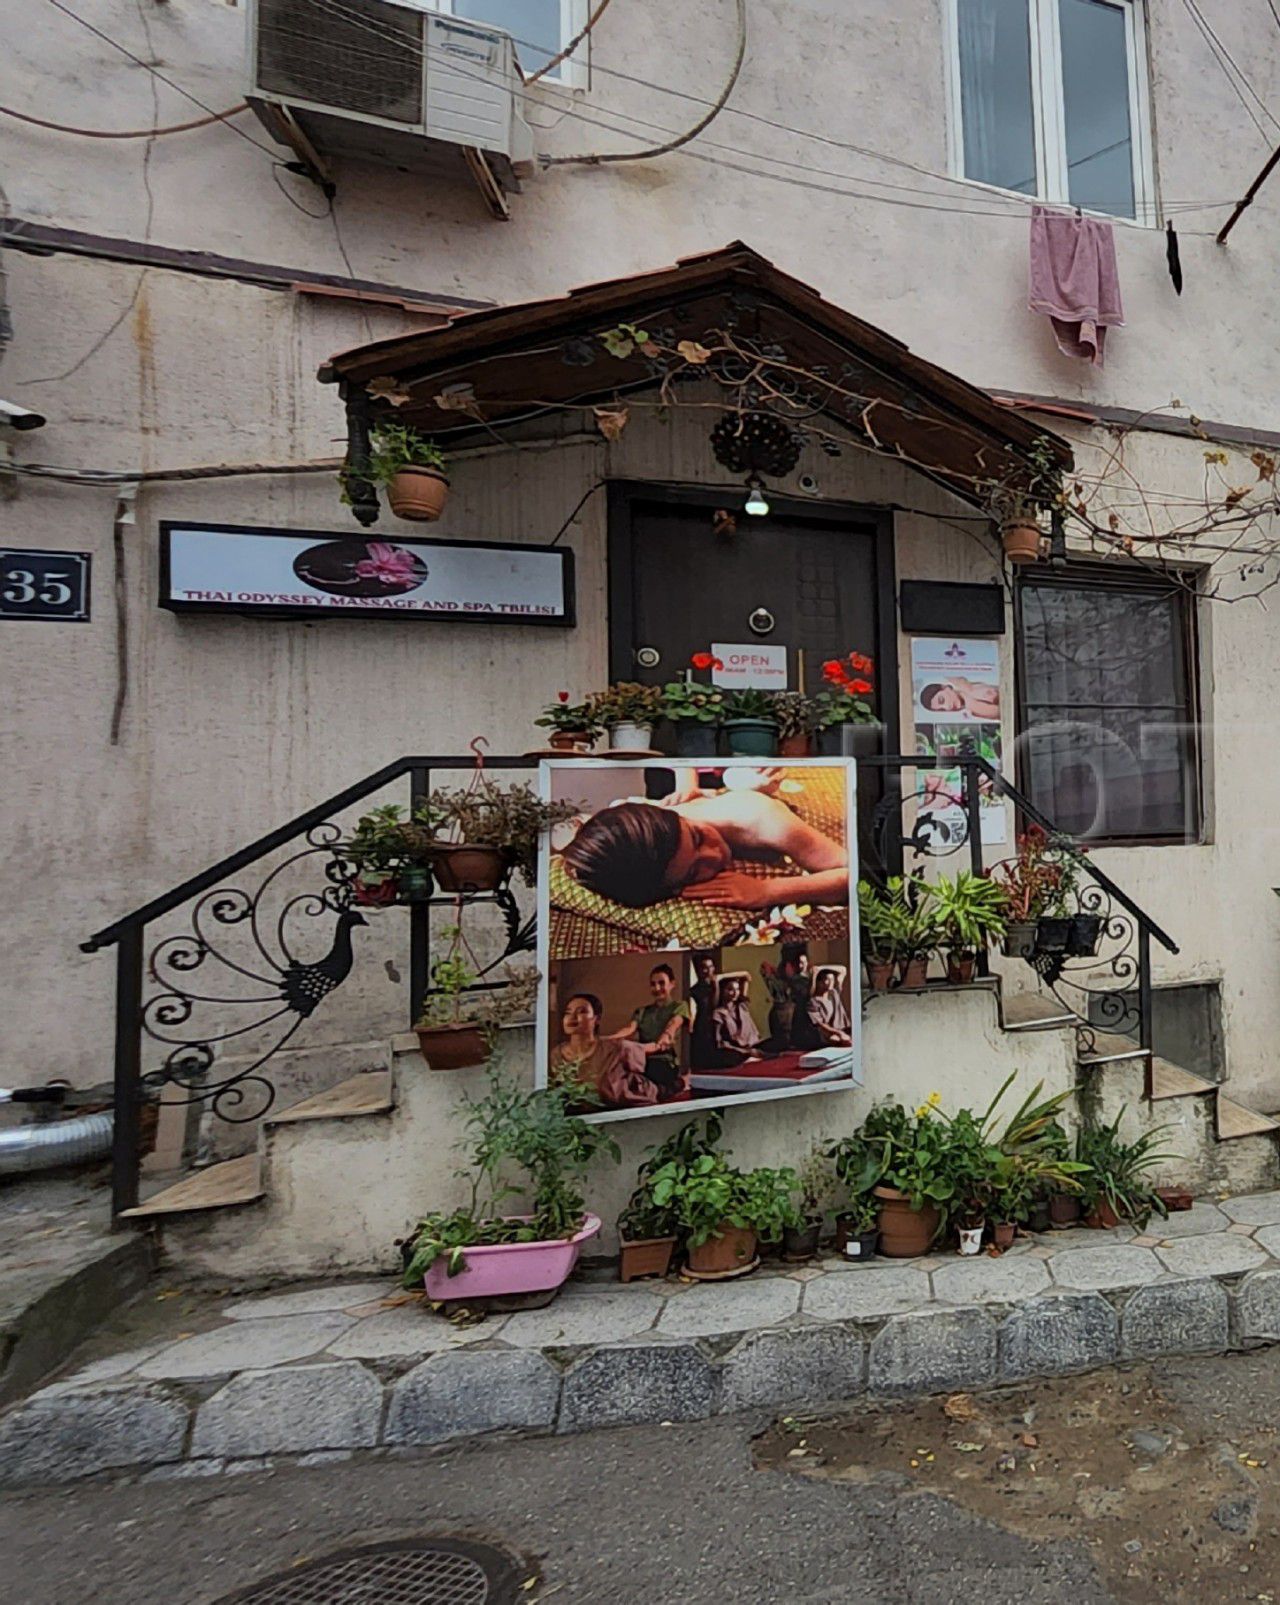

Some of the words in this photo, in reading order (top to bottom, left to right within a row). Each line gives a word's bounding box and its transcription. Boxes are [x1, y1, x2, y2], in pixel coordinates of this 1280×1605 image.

[4, 570, 71, 604] 35
[183, 590, 232, 601] THAI
[238, 592, 324, 605] ODYSSEY
[330, 596, 418, 609] MASSAGE
[422, 600, 459, 611] AND
[463, 601, 494, 612] SPA
[729, 654, 770, 666] OPEN
